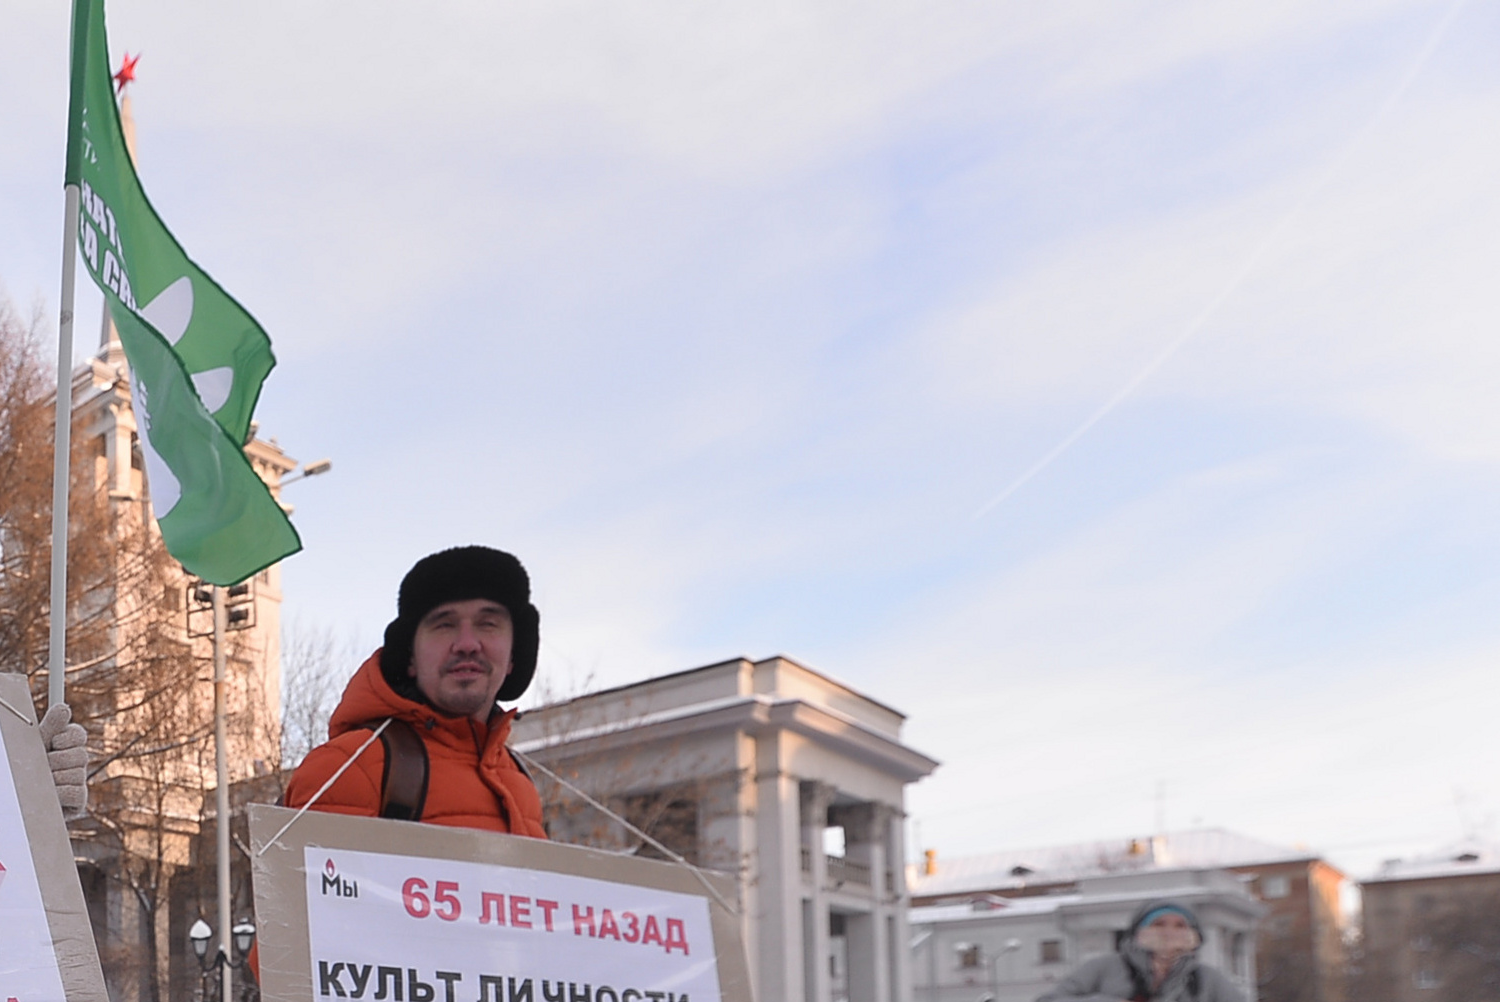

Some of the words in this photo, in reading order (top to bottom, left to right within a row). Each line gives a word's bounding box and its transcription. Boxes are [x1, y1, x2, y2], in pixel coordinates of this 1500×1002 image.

[321, 872, 359, 898] Мы
[401, 876, 462, 922] 65
[478, 891, 560, 933] ЛЕТ
[570, 903, 690, 957] НАЗАД
